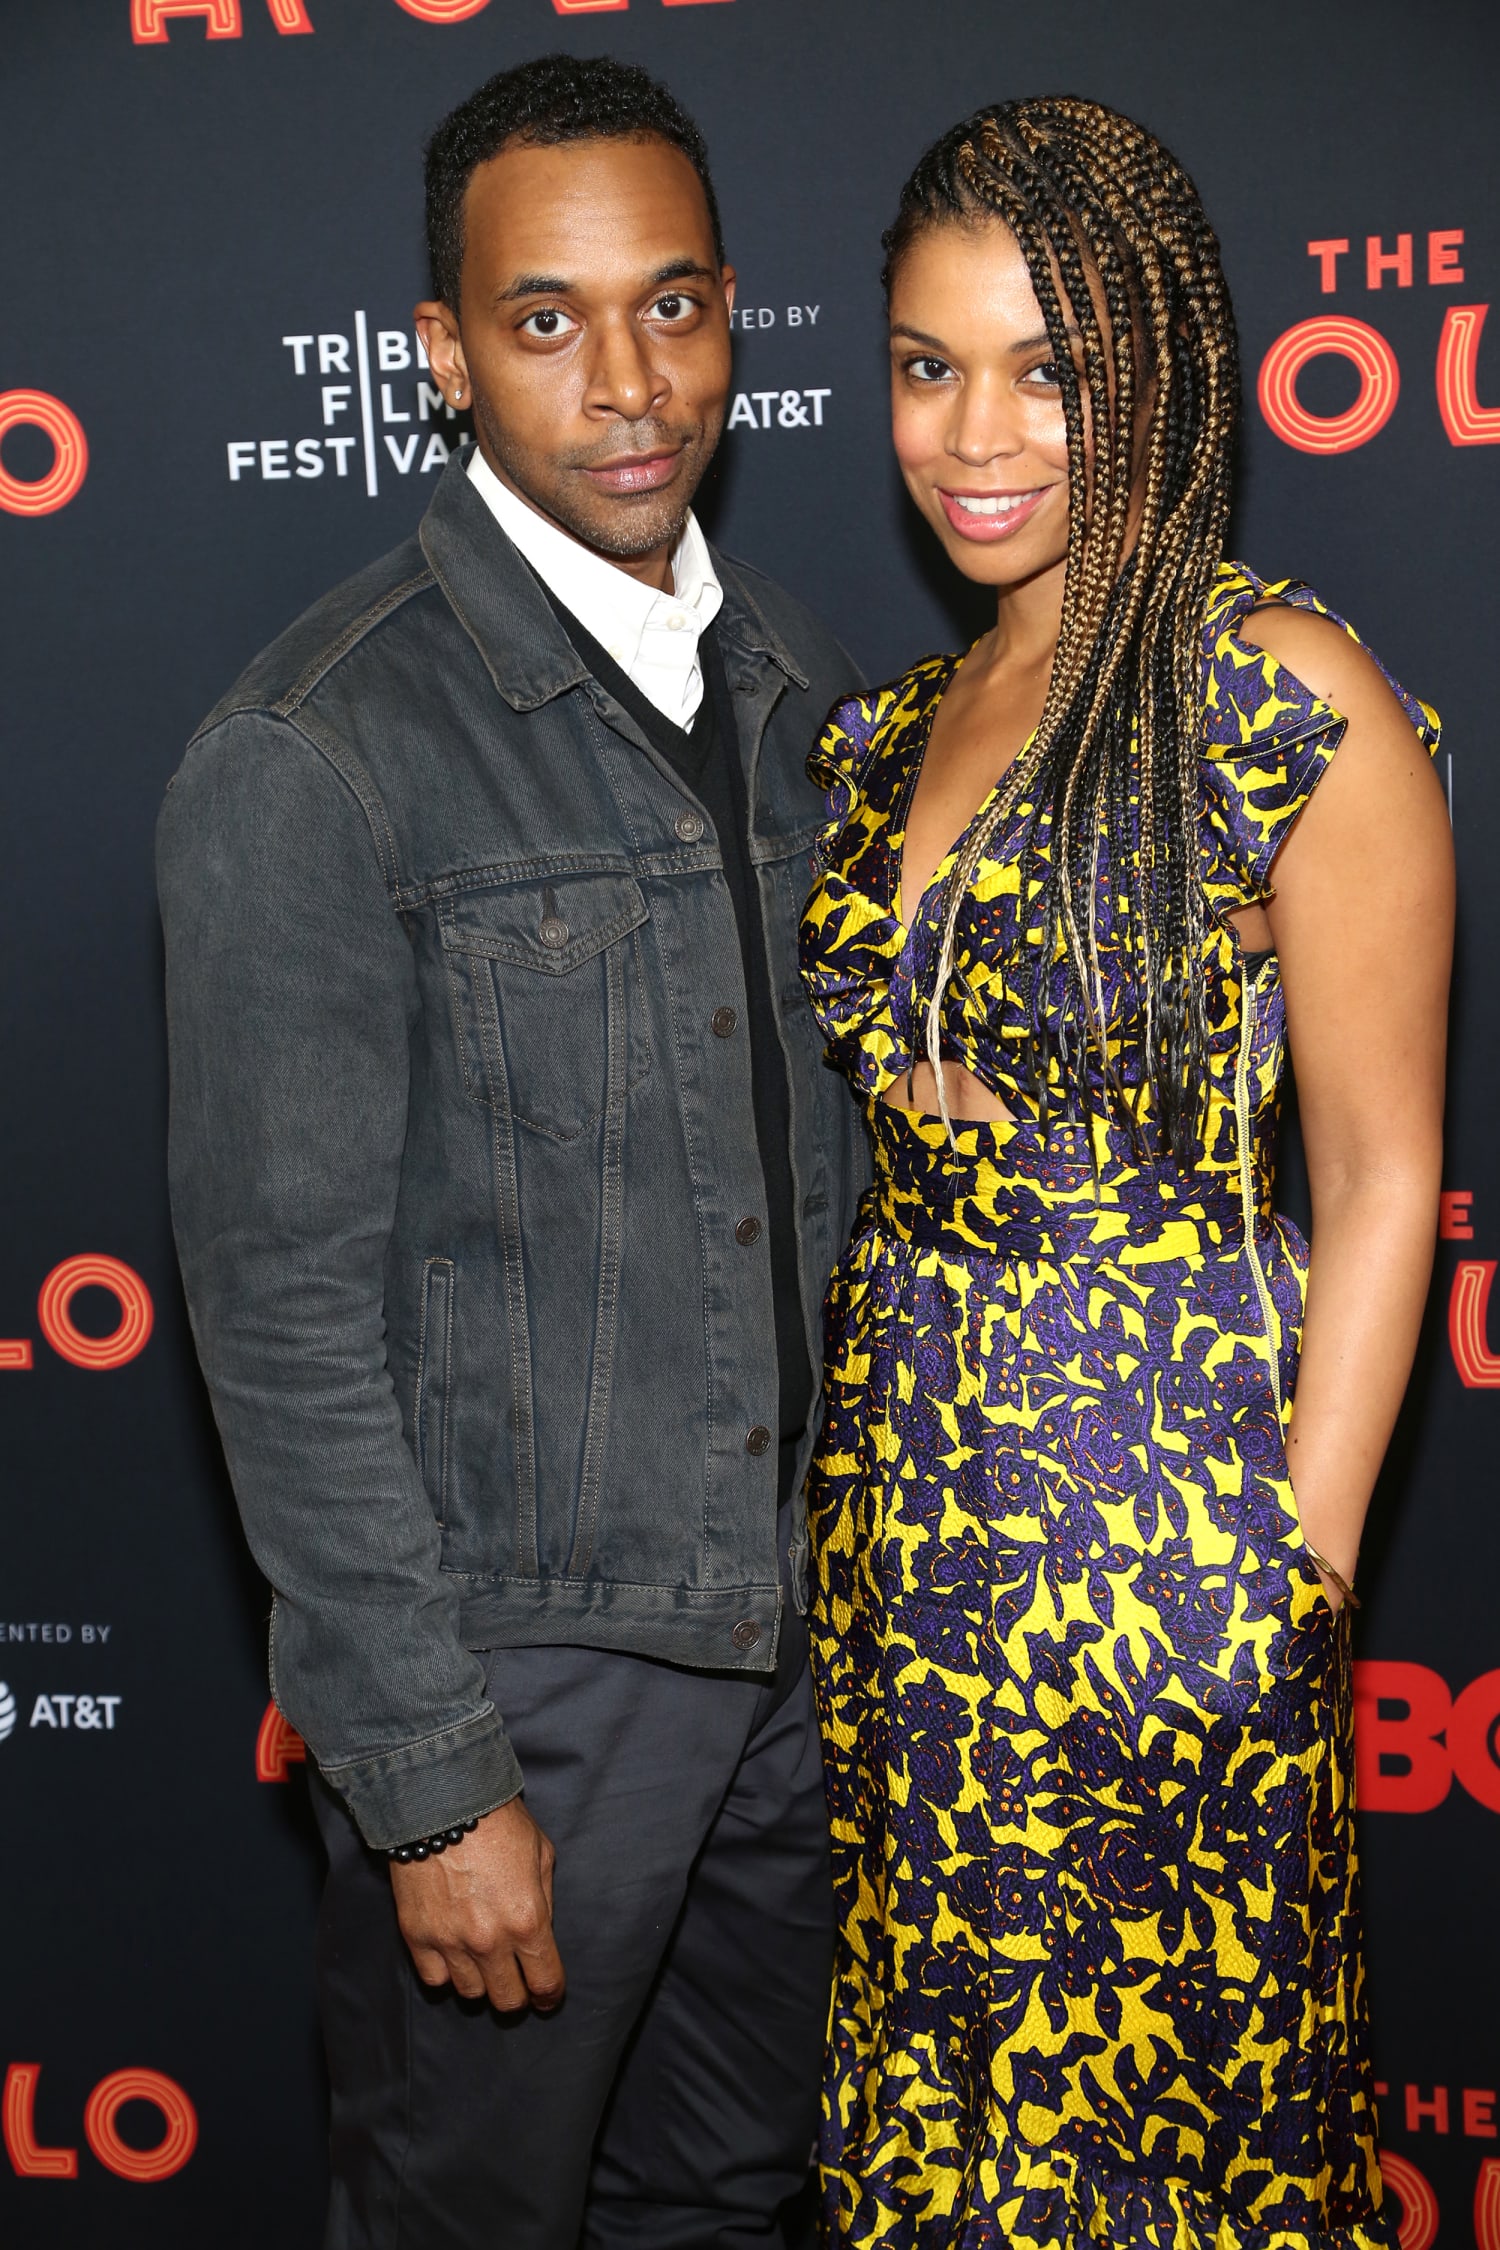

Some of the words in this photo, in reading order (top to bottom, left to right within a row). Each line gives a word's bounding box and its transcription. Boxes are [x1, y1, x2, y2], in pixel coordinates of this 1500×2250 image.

[1308, 229, 1464, 293] THE
[787, 304, 820, 327] BY
[727, 388, 832, 430] AT&T
[81, 1625, 110, 1643] BY
[29, 1694, 122, 1729] AT&T
[2, 2063, 198, 2182] LO
